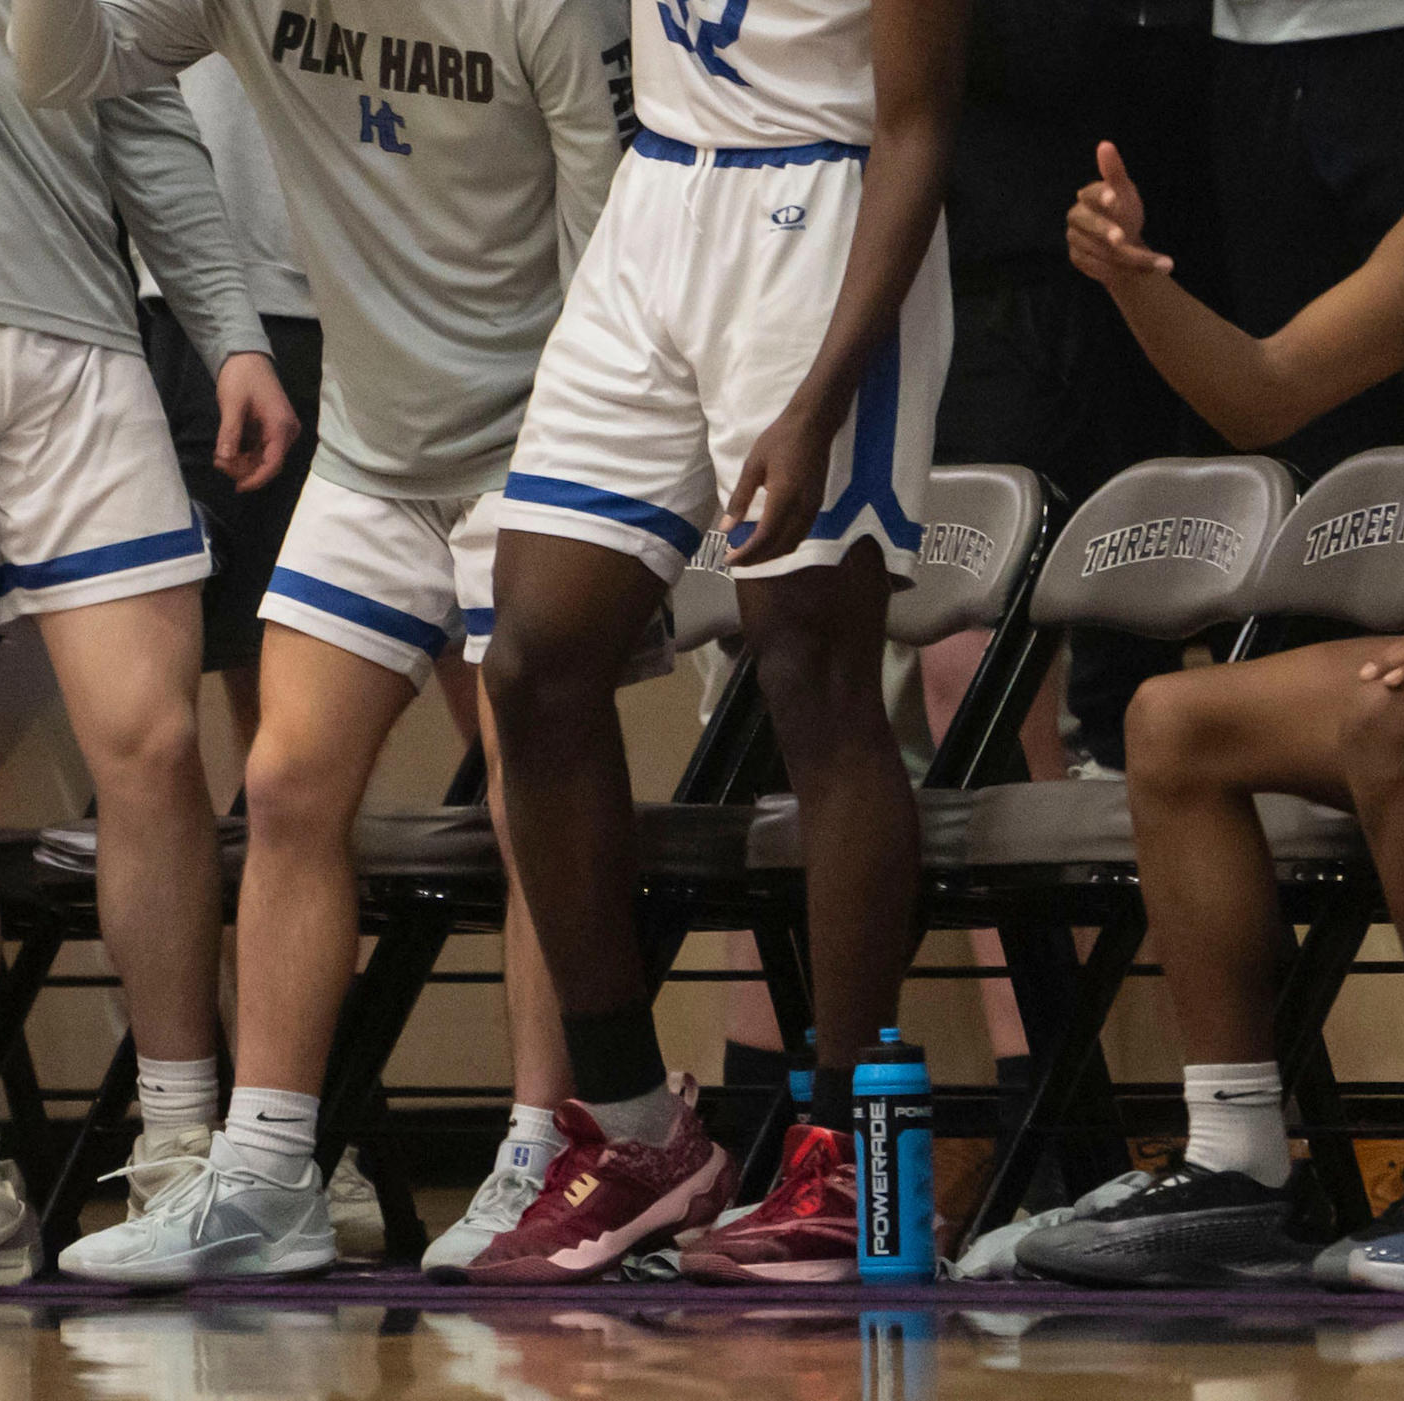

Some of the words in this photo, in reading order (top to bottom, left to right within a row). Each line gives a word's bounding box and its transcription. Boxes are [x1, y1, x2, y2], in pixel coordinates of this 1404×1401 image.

[272, 10, 368, 81] PLAY
[380, 36, 494, 104] HARD
[1081, 517, 1177, 578] THREE
[1172, 517, 1245, 575] RIVERS
[1303, 502, 1400, 565] THREE
[869, 1103, 890, 1256] POWERADE
